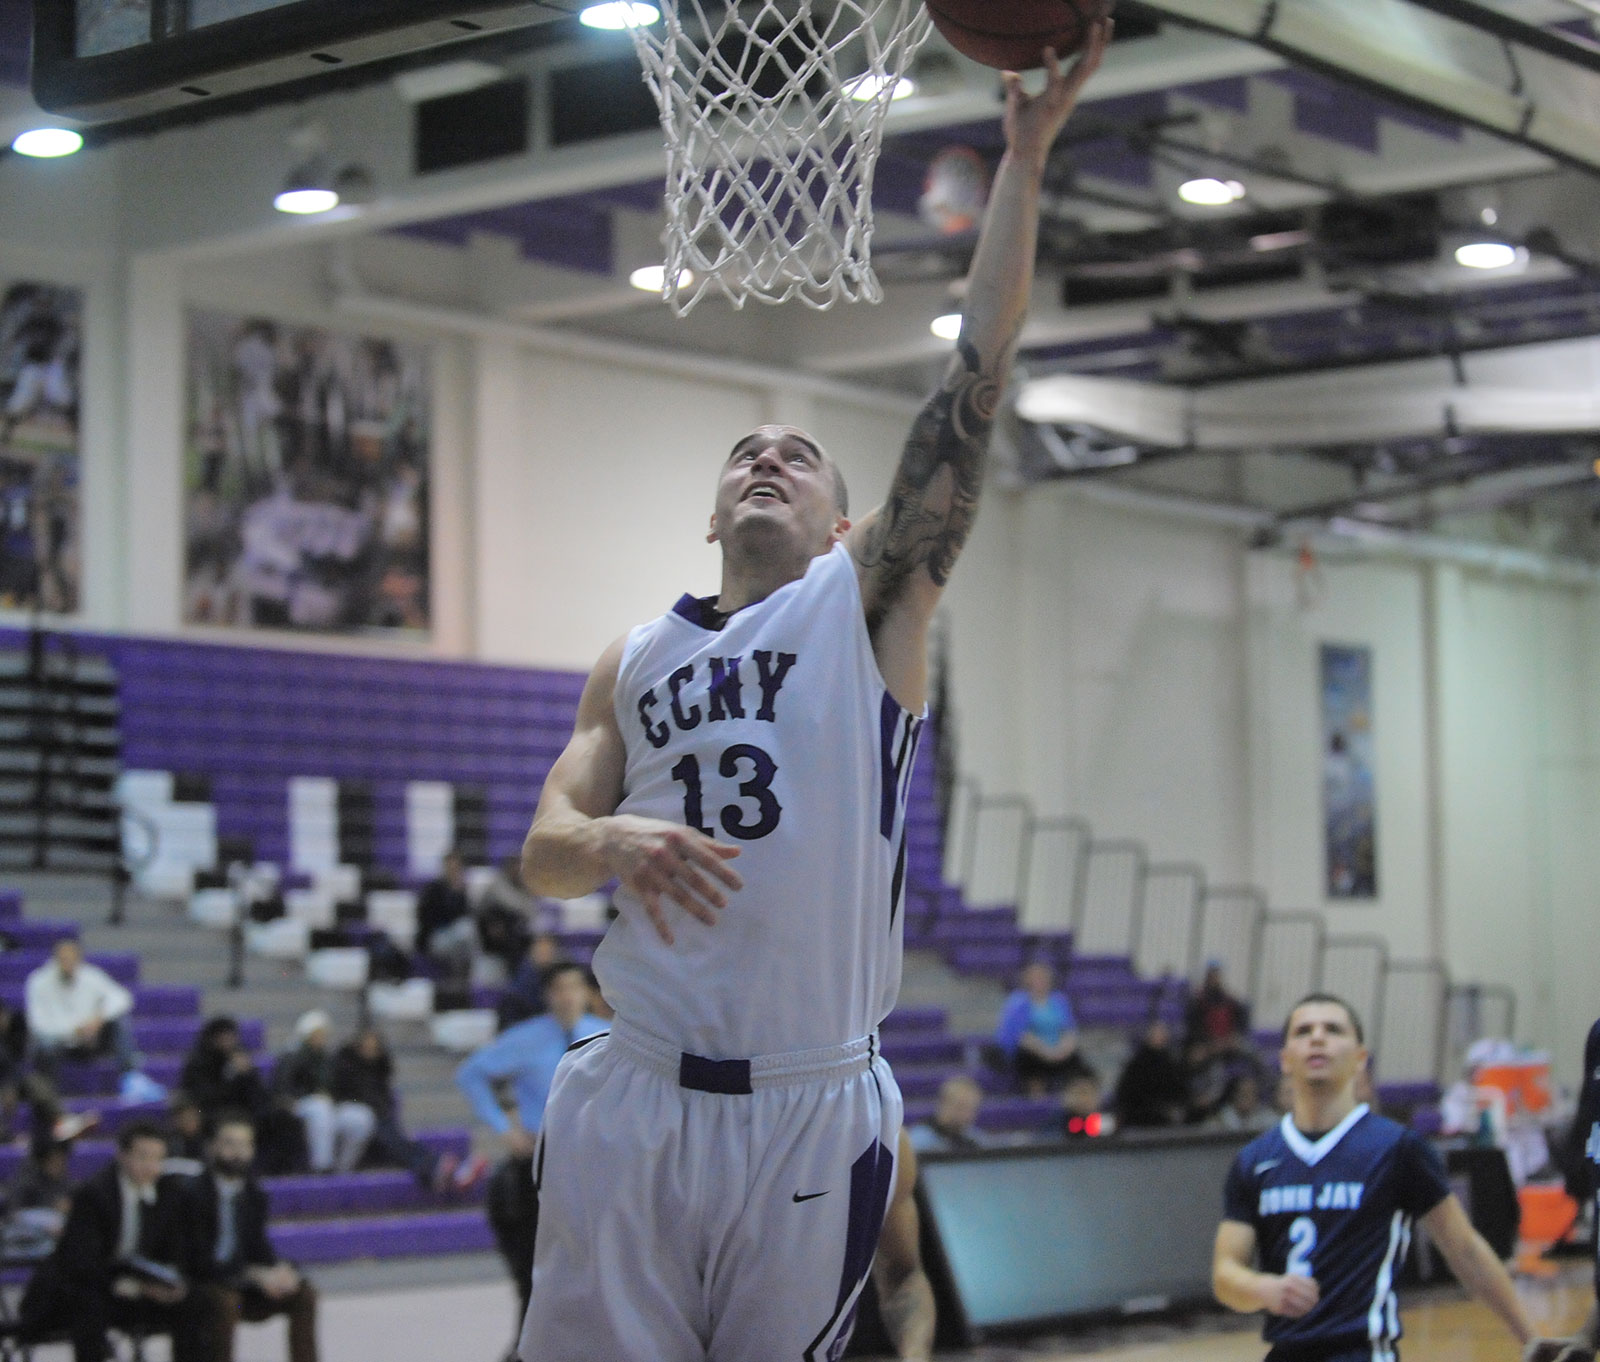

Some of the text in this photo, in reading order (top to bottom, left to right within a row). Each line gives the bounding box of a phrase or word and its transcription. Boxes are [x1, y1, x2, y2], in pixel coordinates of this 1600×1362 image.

[638, 649, 797, 748] CCNY
[671, 743, 783, 841] 13
[1316, 1181, 1364, 1210] JAY
[1286, 1216, 1318, 1278] 2
